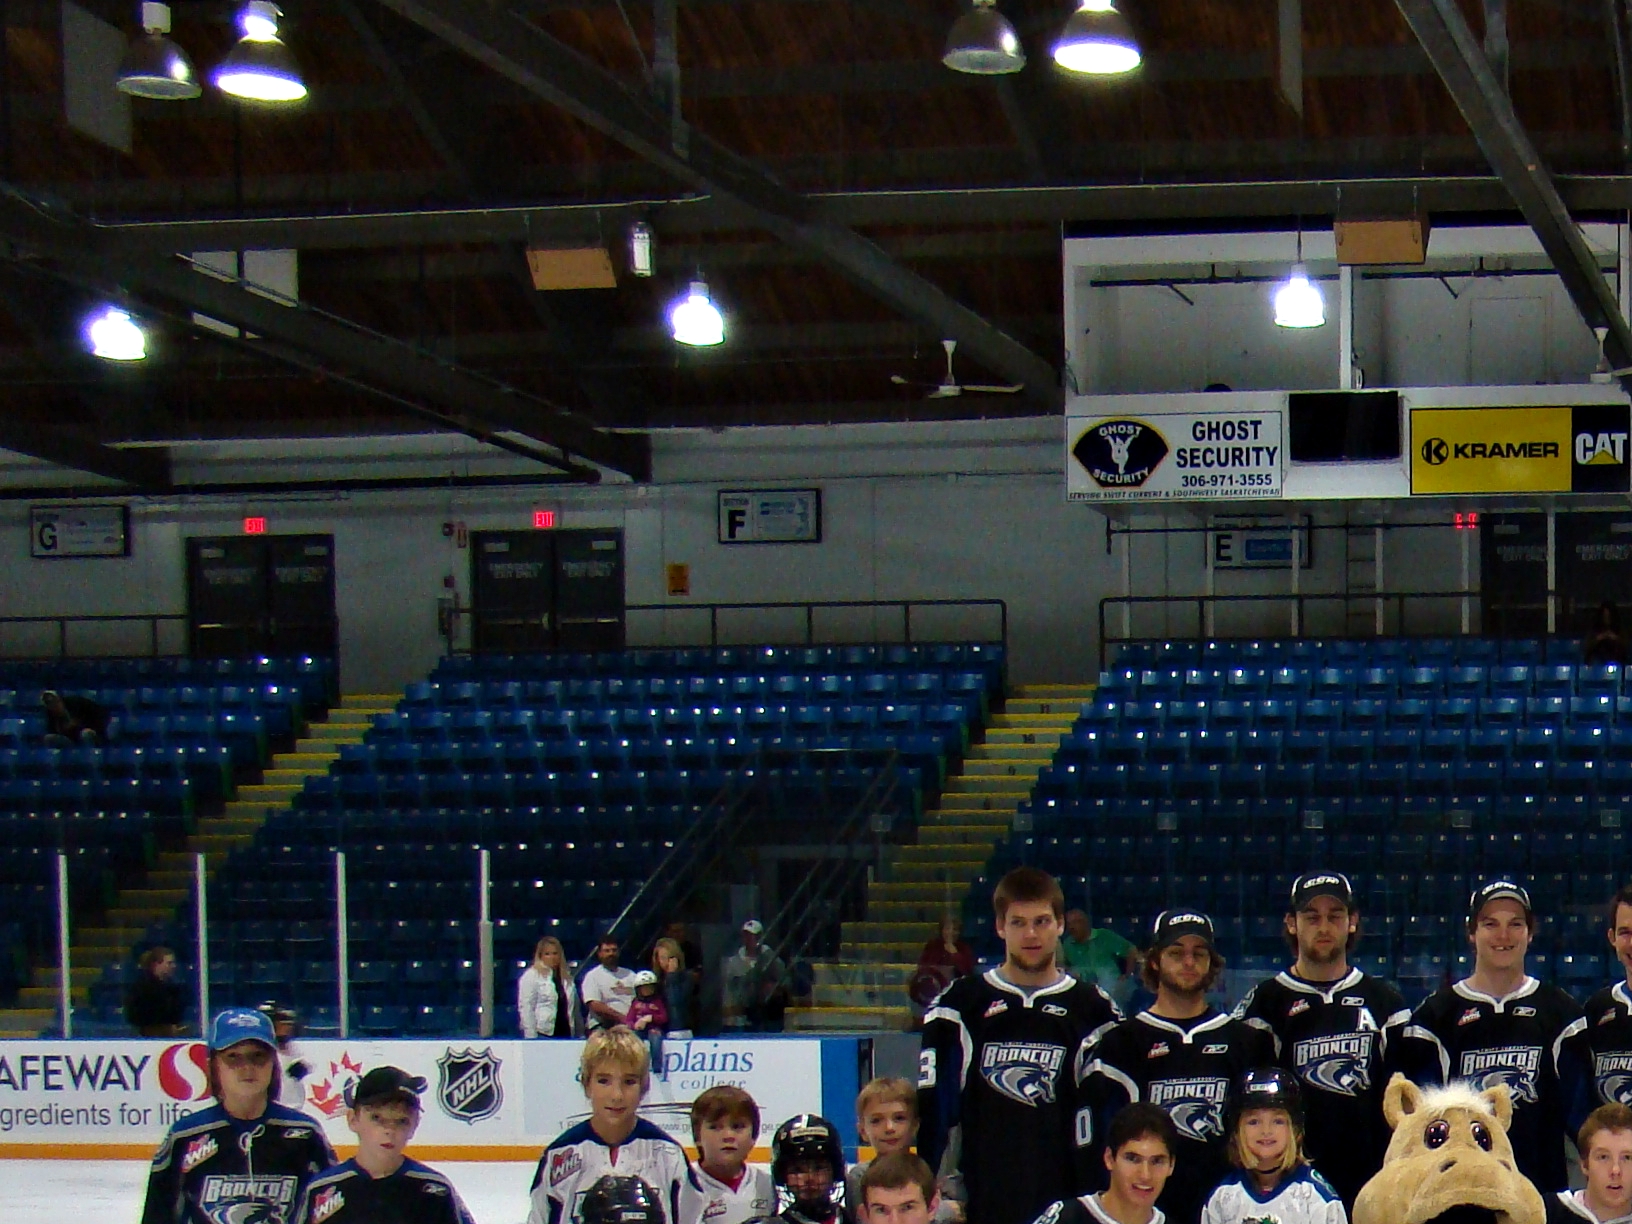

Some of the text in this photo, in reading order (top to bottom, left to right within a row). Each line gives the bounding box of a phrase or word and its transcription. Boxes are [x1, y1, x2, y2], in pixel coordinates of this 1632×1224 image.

[1099, 424, 1143, 437] GHOST
[1192, 420, 1262, 441] GHOST
[1176, 446, 1278, 468] SECURITY
[1454, 442, 1559, 459] KRAMER
[1575, 433, 1628, 465] CAT
[1092, 468, 1149, 484] SECURITY
[1181, 473, 1273, 487] 306-971-3555
[39, 521, 58, 551] G
[727, 509, 747, 539] F
[1215, 534, 1233, 561] E
[1357, 1007, 1379, 1031] A
[663, 1043, 754, 1082] plains
[984, 1045, 1066, 1070] BRONCOS
[1296, 1039, 1371, 1065] BRONCOS
[1463, 1048, 1541, 1074] BRONCOS
[451, 1069, 491, 1108] NHL
[1150, 1080, 1226, 1104] BRONCOS
[1, 1102, 112, 1131] gredients
[119, 1101, 152, 1126] for
[205, 1176, 298, 1203] BRONCOS
